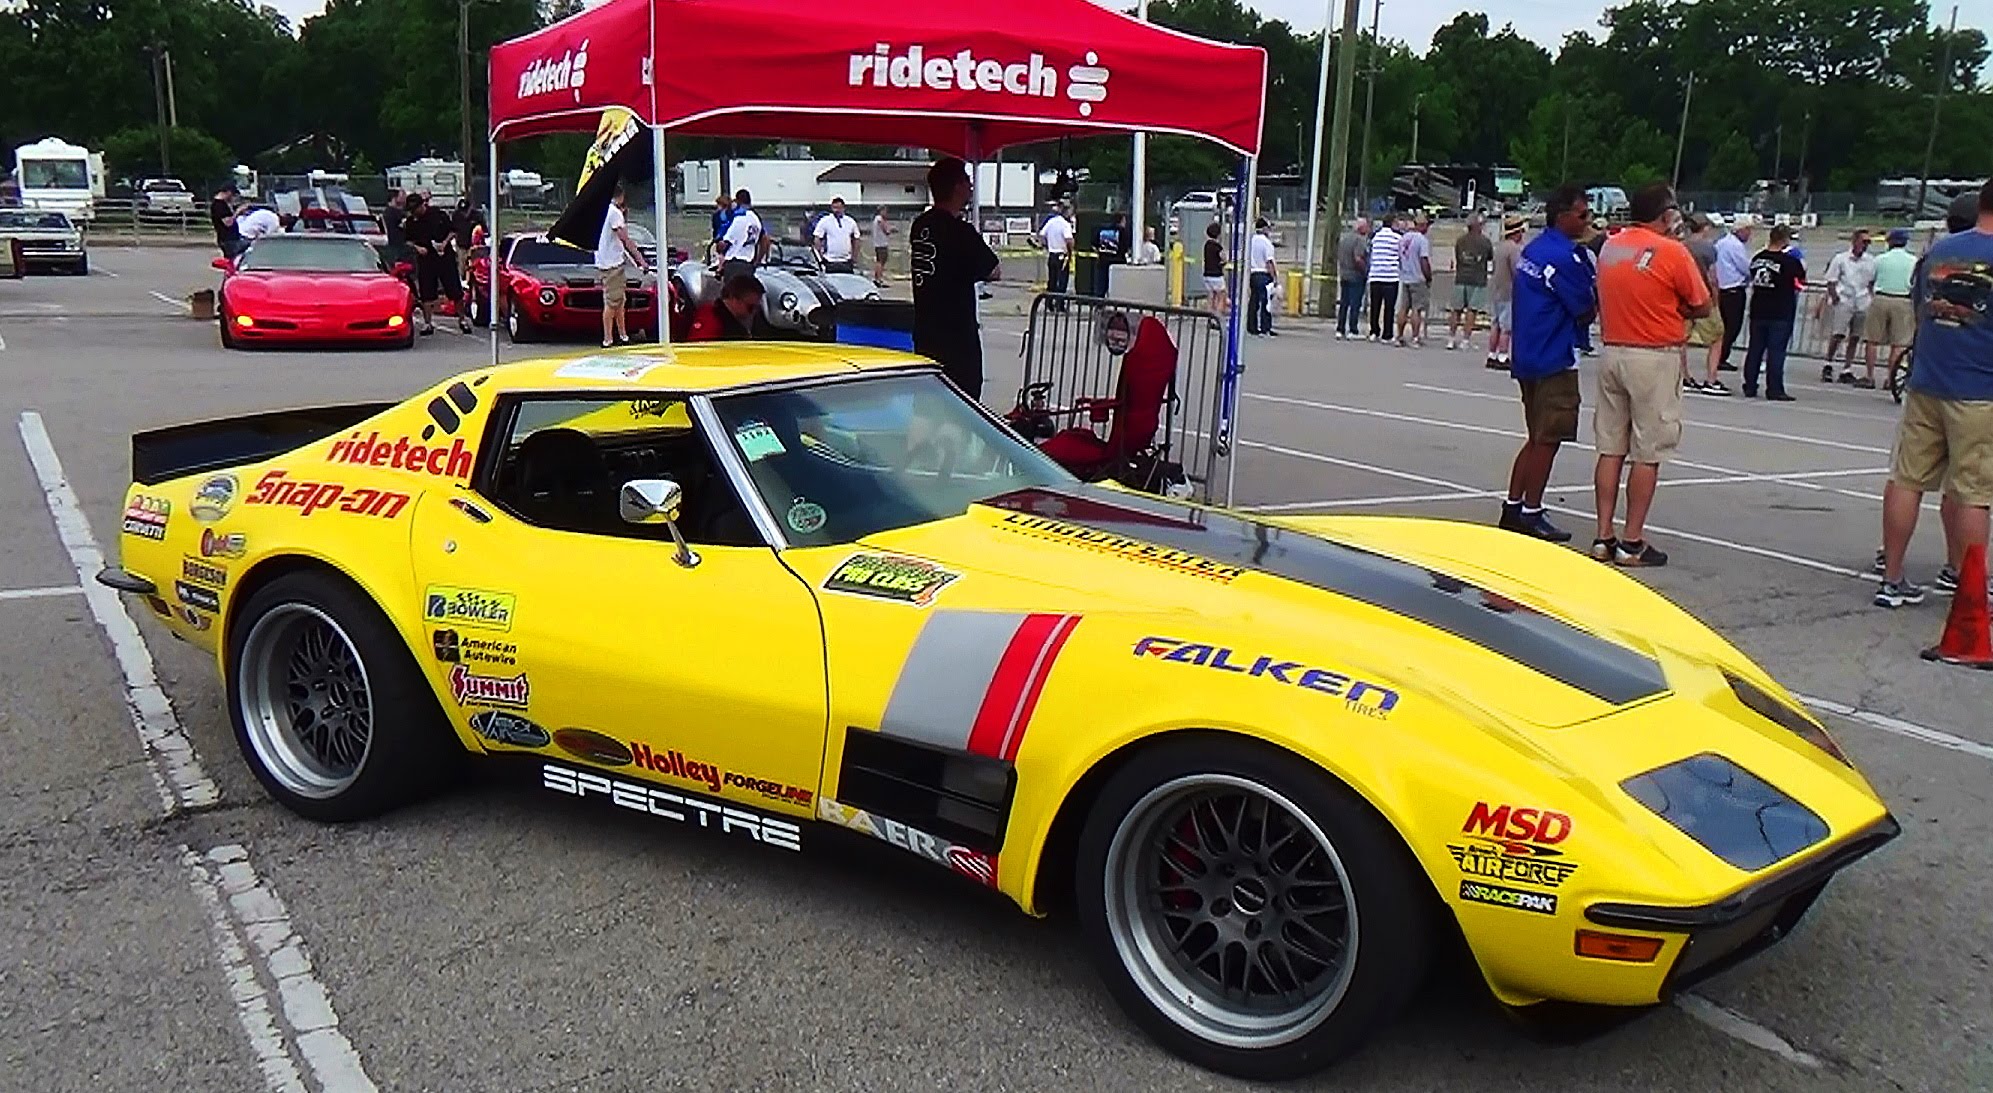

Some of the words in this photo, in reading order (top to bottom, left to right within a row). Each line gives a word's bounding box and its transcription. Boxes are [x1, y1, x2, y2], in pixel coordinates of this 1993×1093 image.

[518, 50, 572, 99] ridetech
[849, 43, 1057, 98] ridetech
[326, 432, 473, 479] ridetech
[245, 470, 410, 519] Snap-on
[461, 637, 517, 654] American
[464, 650, 516, 665] Autowire
[1132, 636, 1400, 712] FALKEN
[630, 742, 721, 792] Holley
[543, 764, 800, 852] SPECTRE
[1462, 801, 1572, 845] MSD
